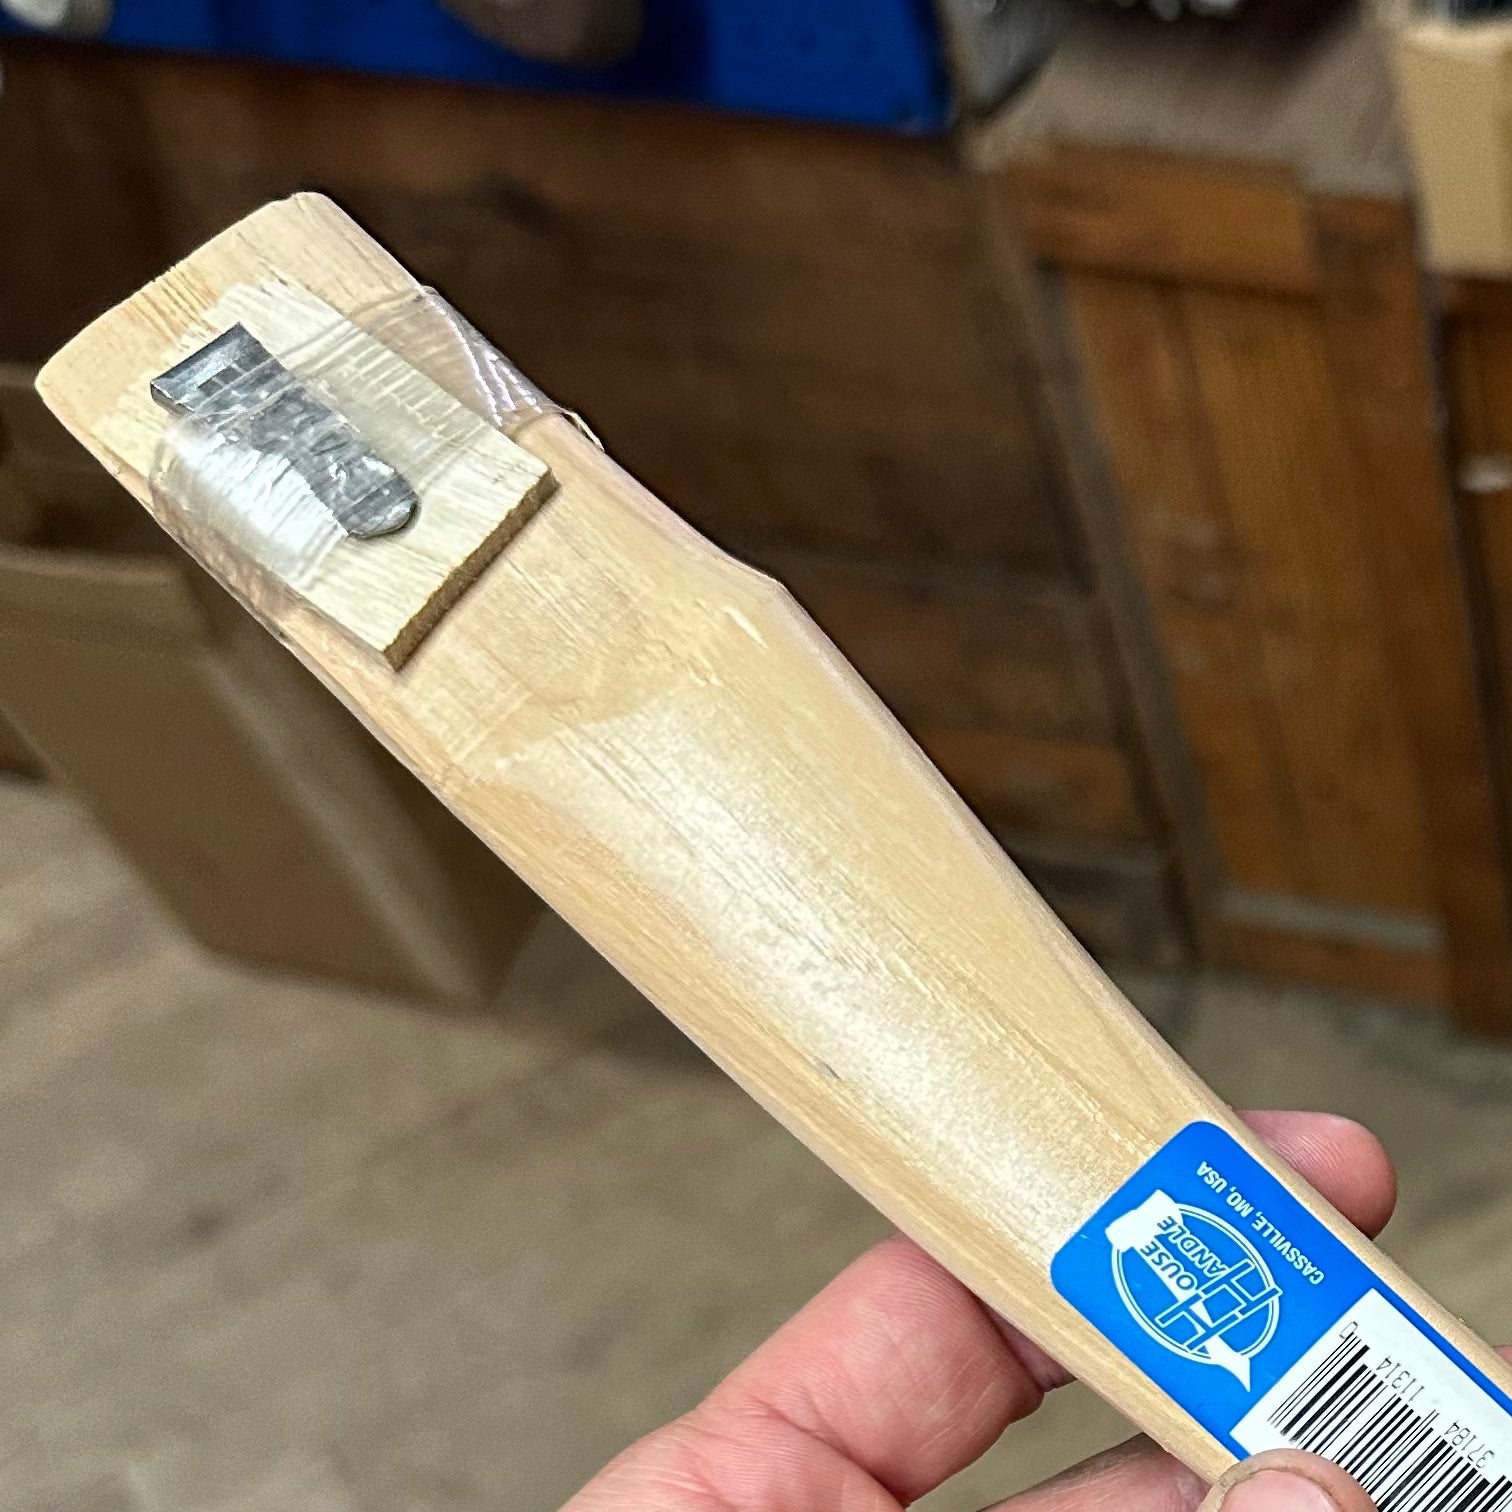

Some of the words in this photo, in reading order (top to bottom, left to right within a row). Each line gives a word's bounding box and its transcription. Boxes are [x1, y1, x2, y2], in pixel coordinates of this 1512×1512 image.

[1196, 1160, 1228, 1194] USA
[1226, 1186, 1255, 1218] MO,
[1156, 1214, 1284, 1320] HANDLE
[1251, 1211, 1325, 1286] CASSVILLE,
[1139, 1239, 1242, 1353] HOUSE
[1375, 1354, 1426, 1403] 11314
[1443, 1419, 1496, 1469] 37184
